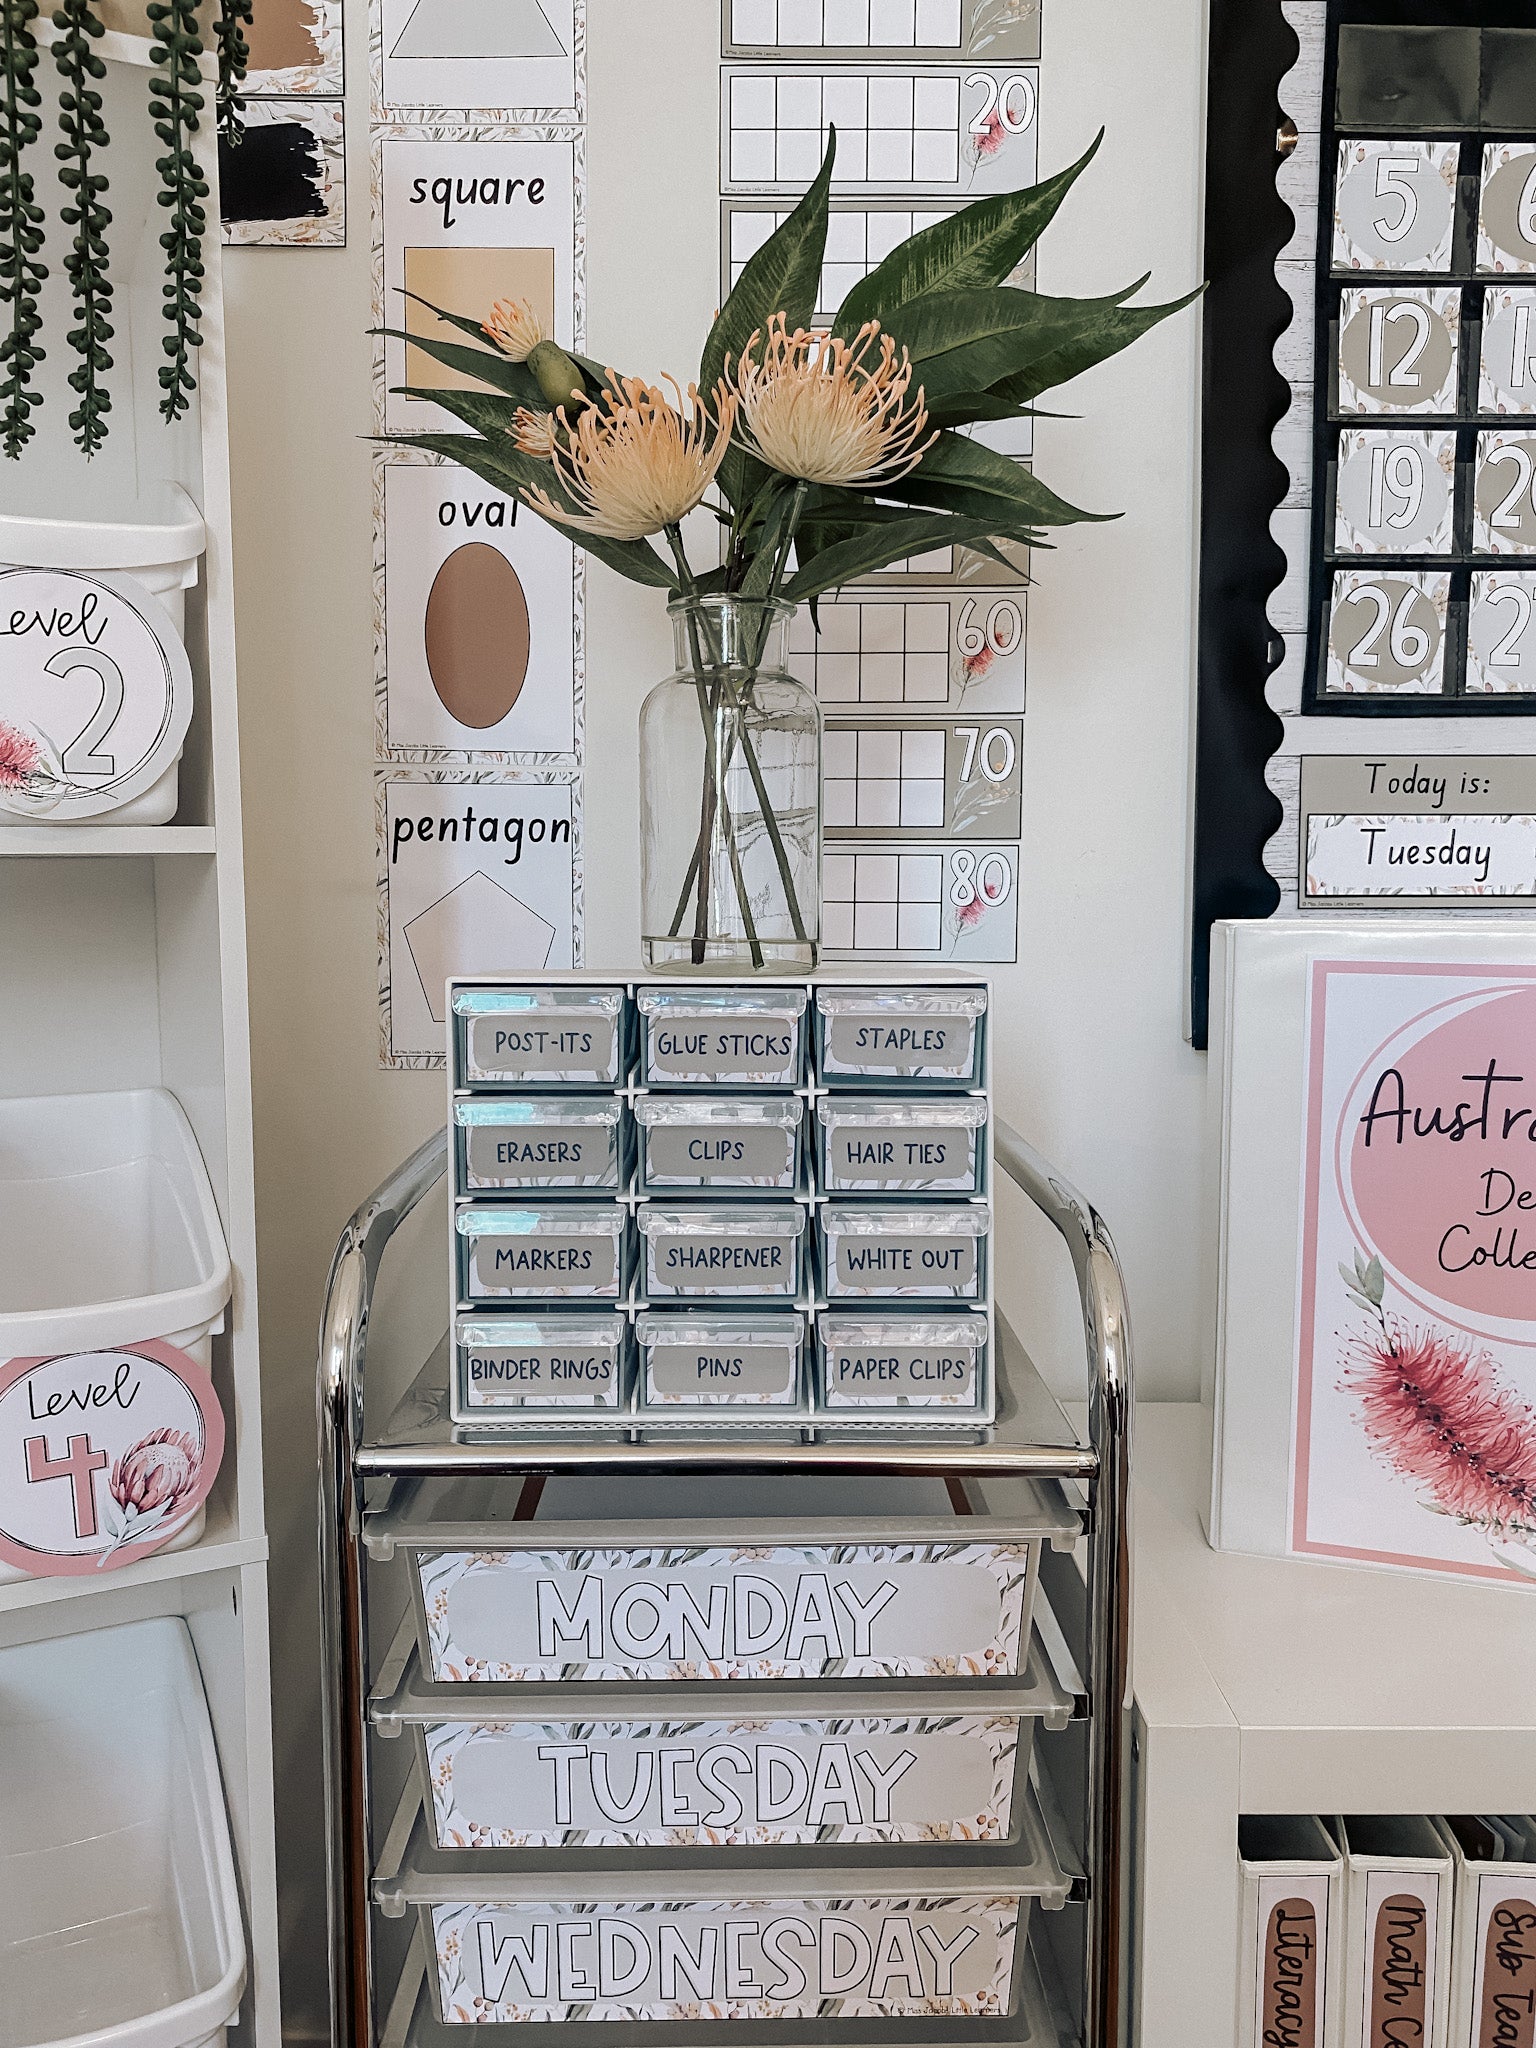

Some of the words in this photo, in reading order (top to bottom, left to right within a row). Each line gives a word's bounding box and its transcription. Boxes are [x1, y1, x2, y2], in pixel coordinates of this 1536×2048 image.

[964, 71, 1036, 134] 20
[409, 177, 545, 229] square
[1373, 157, 1419, 243] 5
[1368, 301, 1431, 388] 12
[1510, 305, 1536, 388] 1
[438, 499, 518, 528] oval
[1368, 445, 1424, 529] 19
[1486, 444, 1536, 529] 2
[0, 592, 108, 645] evel
[957, 597, 1023, 657] 60
[1346, 584, 1430, 668] 26
[1486, 584, 1536, 667] 2
[43, 646, 125, 776] 2
[953, 726, 1016, 783] 70
[1364, 763, 1447, 809] Today
[1461, 772, 1490, 794] is:
[392, 806, 570, 865] pentagon
[1360, 828, 1491, 882] Tuesday
[949, 849, 1013, 908] 80
[496, 1032, 593, 1054] POST-ITS
[658, 1033, 707, 1056] GLUE
[716, 1034, 792, 1056] STICKS
[856, 1027, 947, 1051] STAPLES
[497, 1141, 582, 1164] ERASERS
[688, 1139, 745, 1161] CLIPS
[847, 1142, 894, 1165] HAIR
[904, 1143, 947, 1165] TIES
[1475, 1167, 1536, 1217] De
[496, 1248, 593, 1271] MARKERS
[666, 1246, 782, 1269] SHARPENER
[847, 1248, 912, 1271] WHITE
[922, 1249, 964, 1270] OUT
[1438, 1223, 1536, 1274] Colle
[28, 1363, 141, 1420] Level
[471, 1358, 541, 1381] BINDER
[550, 1358, 612, 1381] RINGS
[697, 1356, 744, 1379] PINS
[839, 1358, 900, 1381] PAPER
[909, 1358, 966, 1380] CLIPS
[24, 1433, 109, 1539] 4
[536, 1573, 899, 1661] MONDAY
[538, 1743, 918, 1828] TUESDAY
[477, 1917, 980, 2002] WEDNESDAY
[1382, 1906, 1426, 2005] Math
[1494, 1909, 1536, 1976] Sub
[1492, 1989, 1534, 2048] Tea
